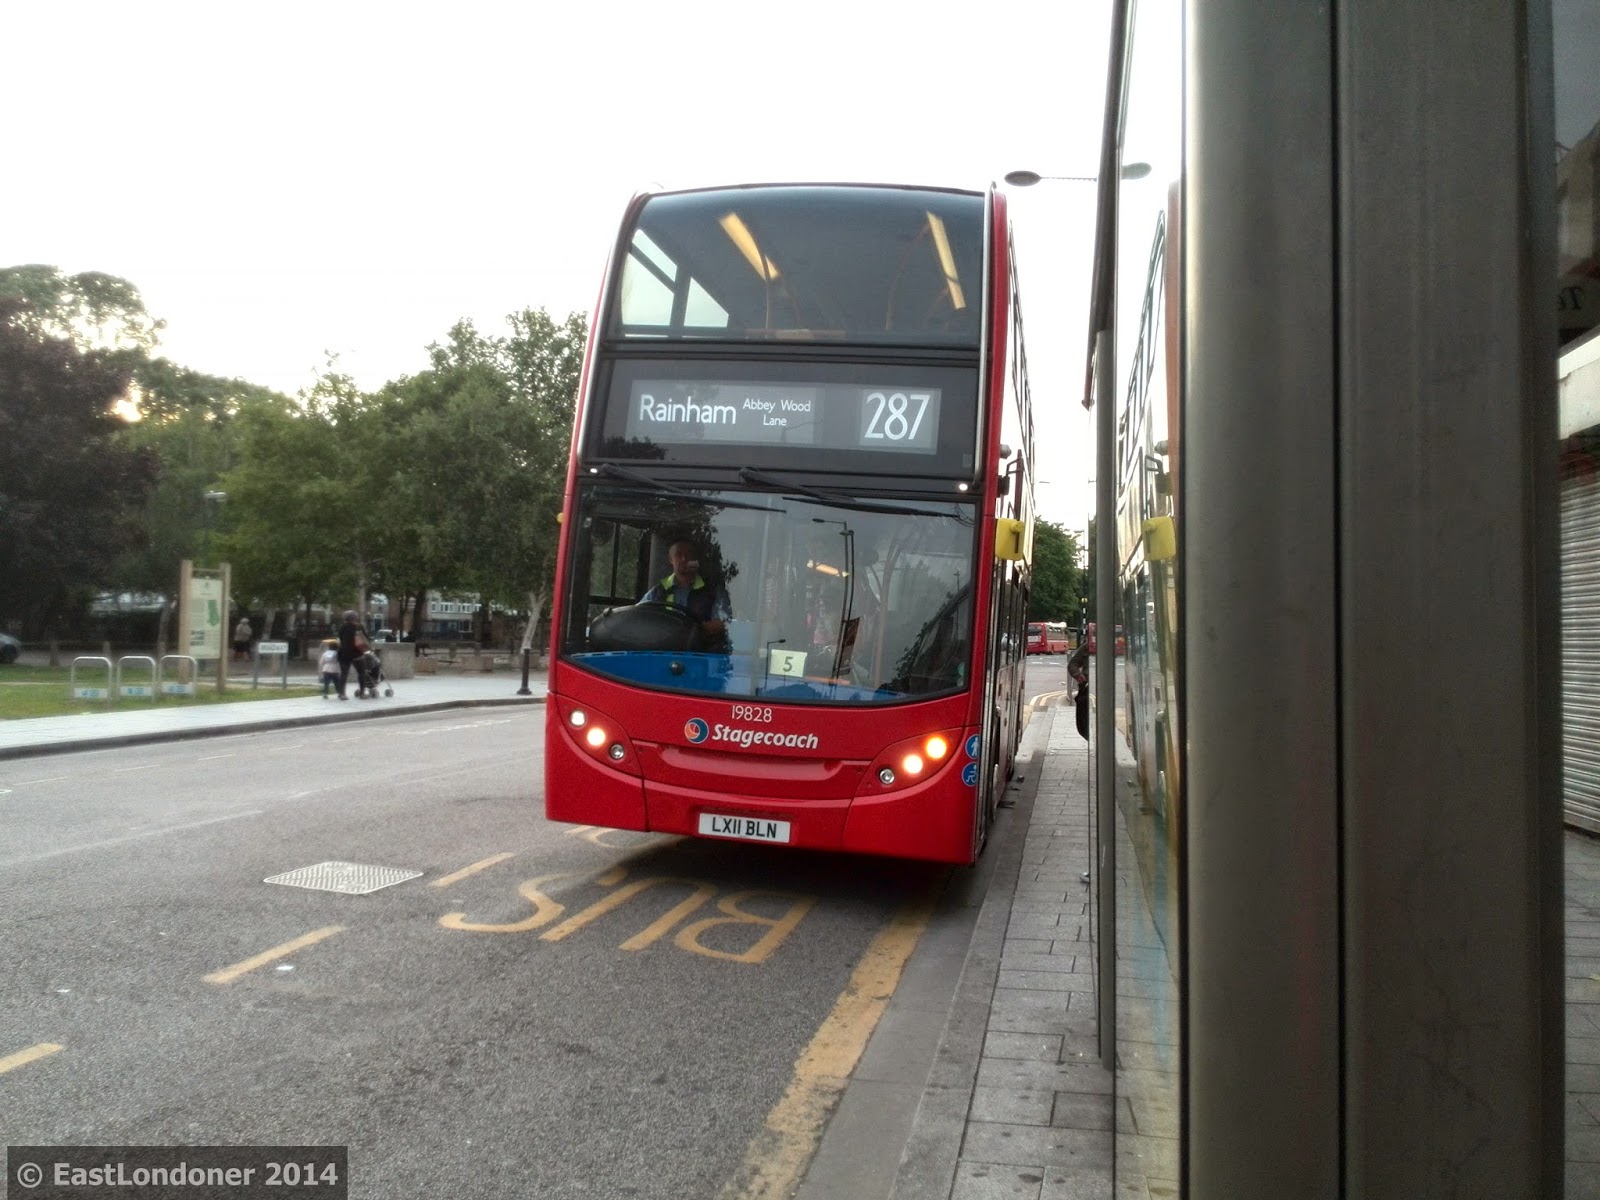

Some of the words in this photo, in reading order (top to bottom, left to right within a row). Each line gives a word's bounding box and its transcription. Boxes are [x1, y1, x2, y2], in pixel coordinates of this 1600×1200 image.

[639, 394, 737, 425] Rainham
[742, 398, 776, 414] Abbey
[780, 399, 811, 413] Wood
[864, 391, 931, 441] 287
[762, 414, 788, 428] Lane
[782, 656, 793, 672] 5
[731, 705, 772, 722] 19828
[712, 723, 818, 749] Stagecoach
[712, 817, 741, 834] LX11
[745, 820, 777, 838] BLN
[439, 868, 814, 963] BUS
